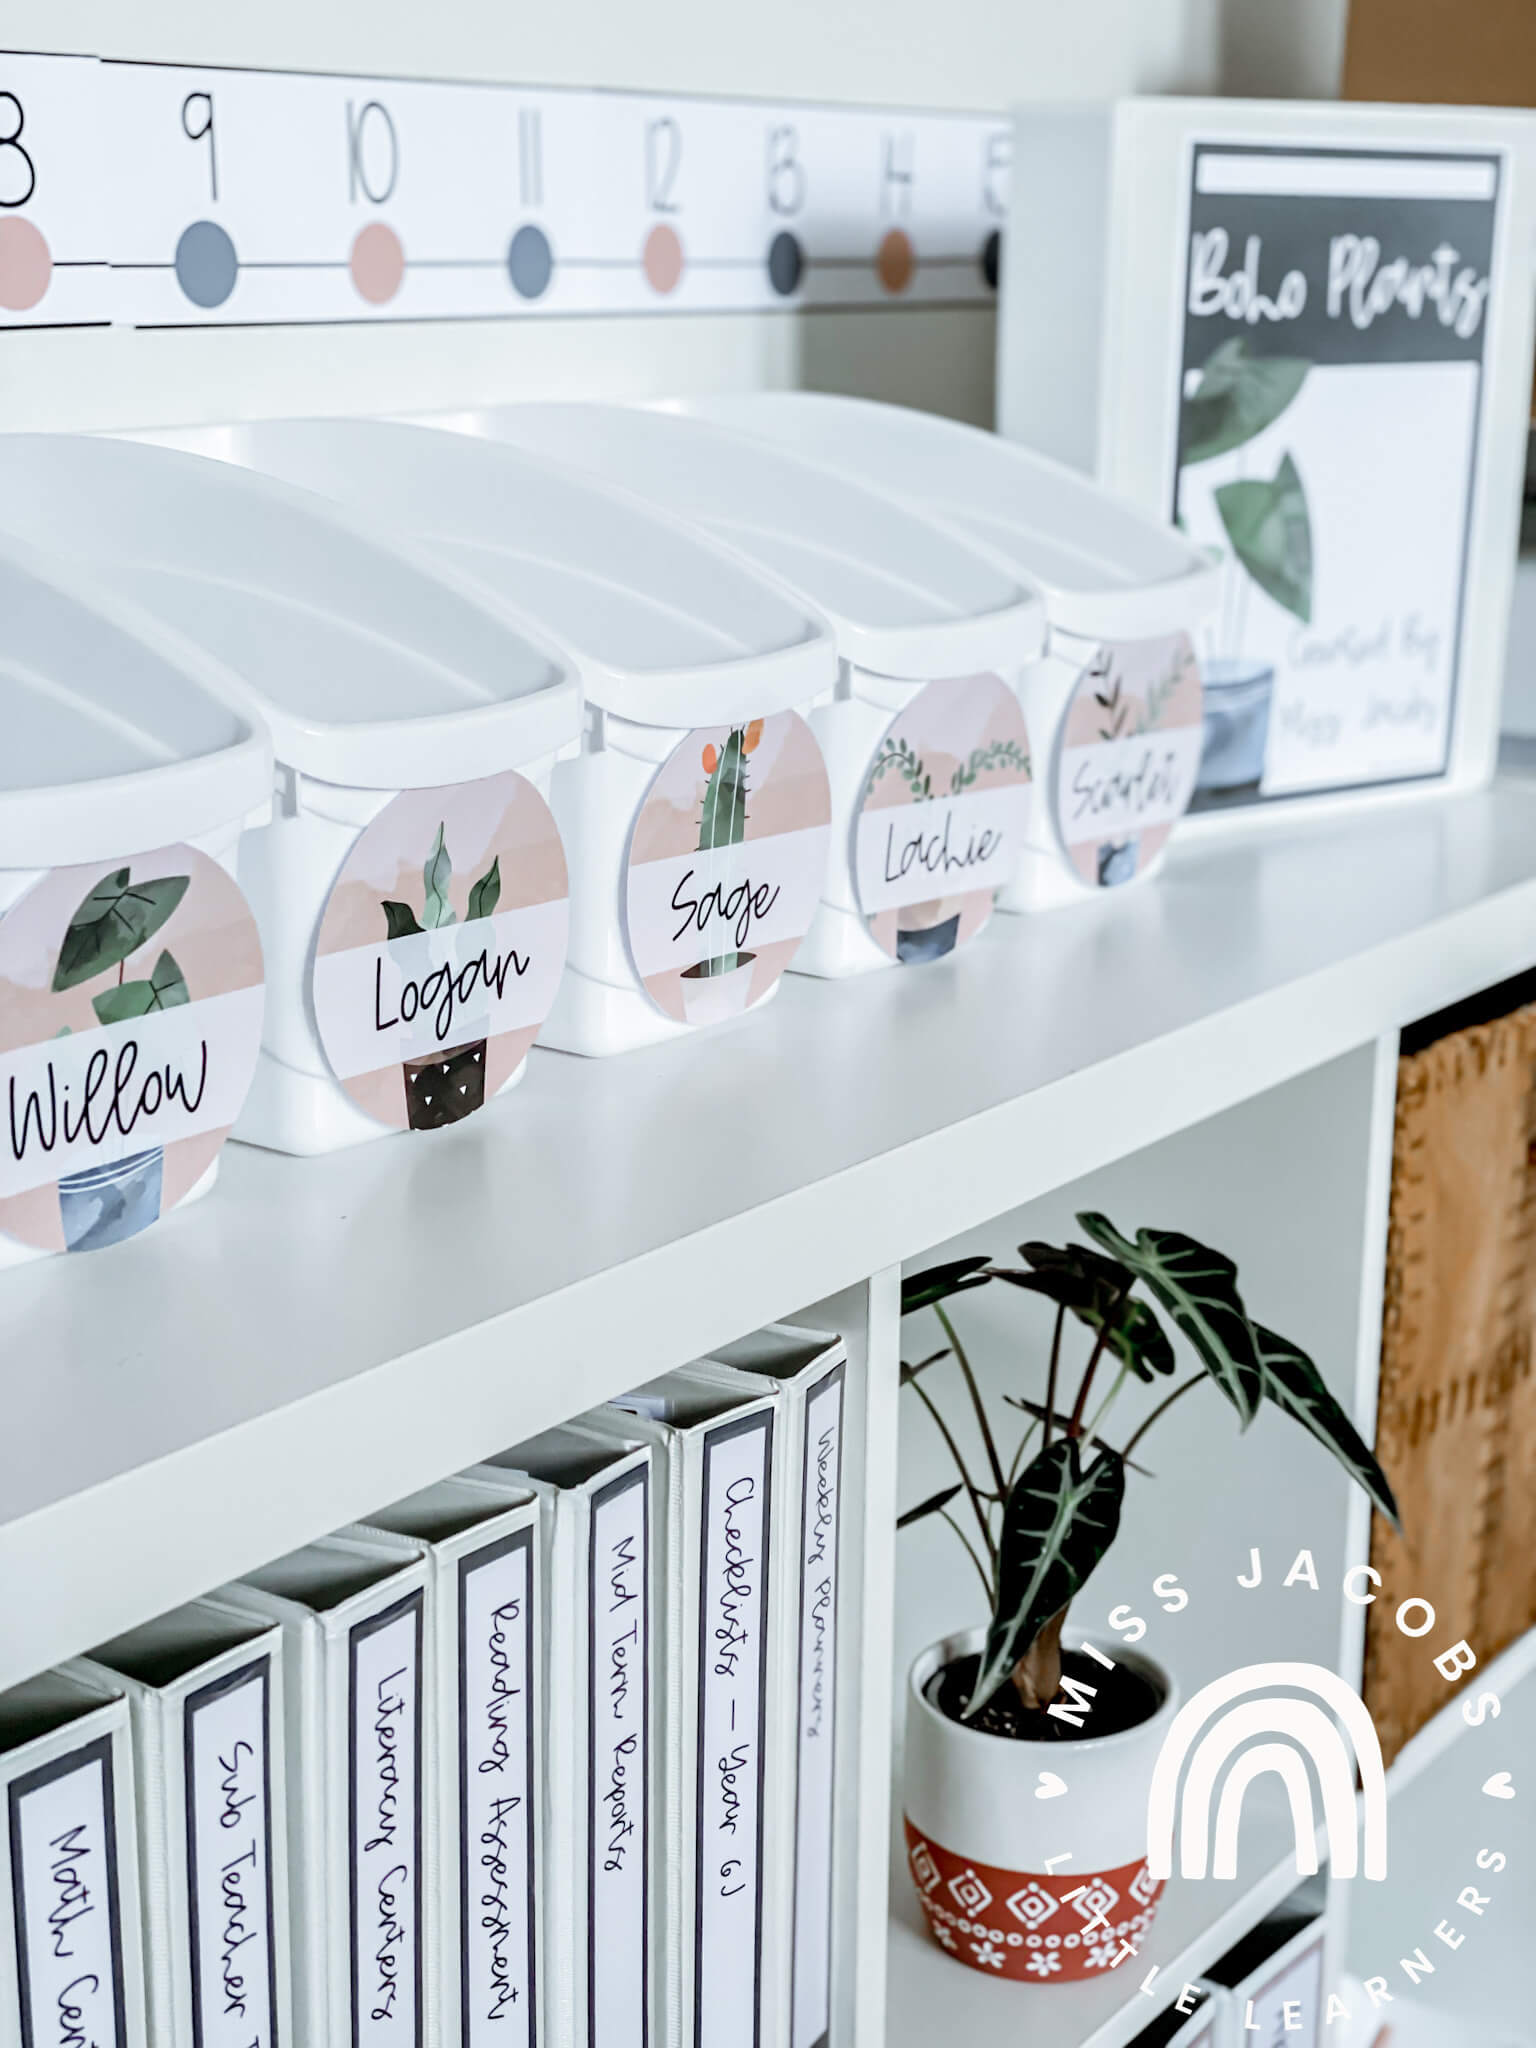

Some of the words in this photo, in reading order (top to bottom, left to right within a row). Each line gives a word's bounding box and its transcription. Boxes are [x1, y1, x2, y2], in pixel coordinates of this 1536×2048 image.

[182, 92, 218, 202] 9
[346, 100, 399, 205] 10
[518, 106, 544, 207] 11
[645, 115, 684, 214] 12
[1189, 226, 1308, 326] Boho
[1326, 232, 1490, 338] Plants
[883, 810, 1003, 884] Lachie
[671, 868, 781, 949] Sage
[375, 948, 531, 1041] Logan
[8, 1039, 208, 1162] Willow
[807, 1425, 835, 1565] Weekly
[609, 1536, 636, 1613] Mid
[713, 1476, 753, 1677] Checklists
[478, 1599, 521, 1773] Reading
[608, 1619, 640, 1719] Term
[218, 1741, 256, 1828] Sub
[364, 1666, 408, 1852] Literacy
[603, 1734, 638, 1874] Reports
[717, 1743, 751, 1835] Year
[48, 1825, 95, 1958] Math
[220, 1839, 258, 2019] Teacher
[370, 1865, 409, 2021] Centers
[480, 1797, 521, 2020] Assessment
[57, 1973, 99, 2048] Cen
